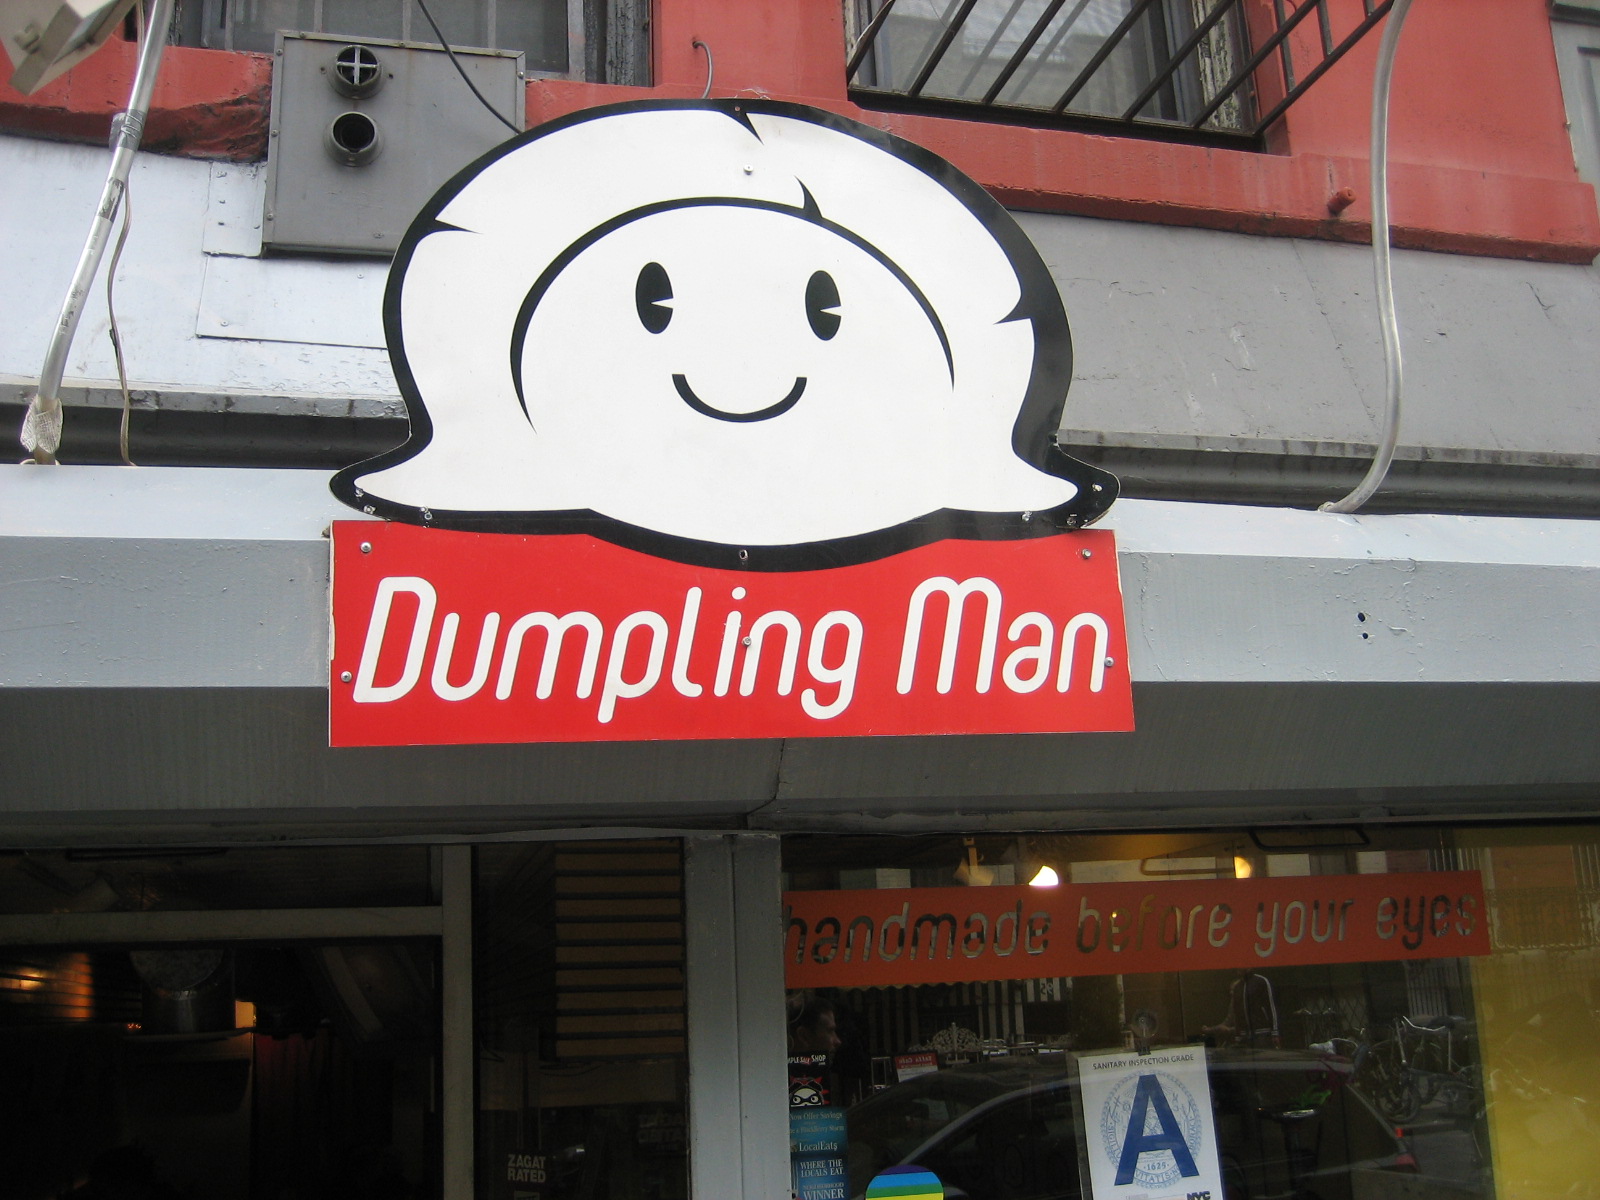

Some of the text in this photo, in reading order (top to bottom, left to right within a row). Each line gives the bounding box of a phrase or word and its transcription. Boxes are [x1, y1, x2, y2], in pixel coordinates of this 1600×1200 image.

[352, 576, 1109, 723] Dumpling Man
[784, 893, 1478, 965] handmade before your eyes
[811, 1054, 827, 1063] SHOP
[1092, 1053, 1195, 1070] SANITARY INSPECTION GRADE
[1114, 1073, 1200, 1186] A
[799, 1140, 838, 1152] LocalEats
[507, 1153, 546, 1169] ZAGAT
[800, 1158, 843, 1170] WHERE THE
[507, 1167, 547, 1183] RATED
[801, 1168, 828, 1178] LOCALS
[803, 1188, 845, 1200] WINNER
[1186, 1190, 1211, 1200] NYC
